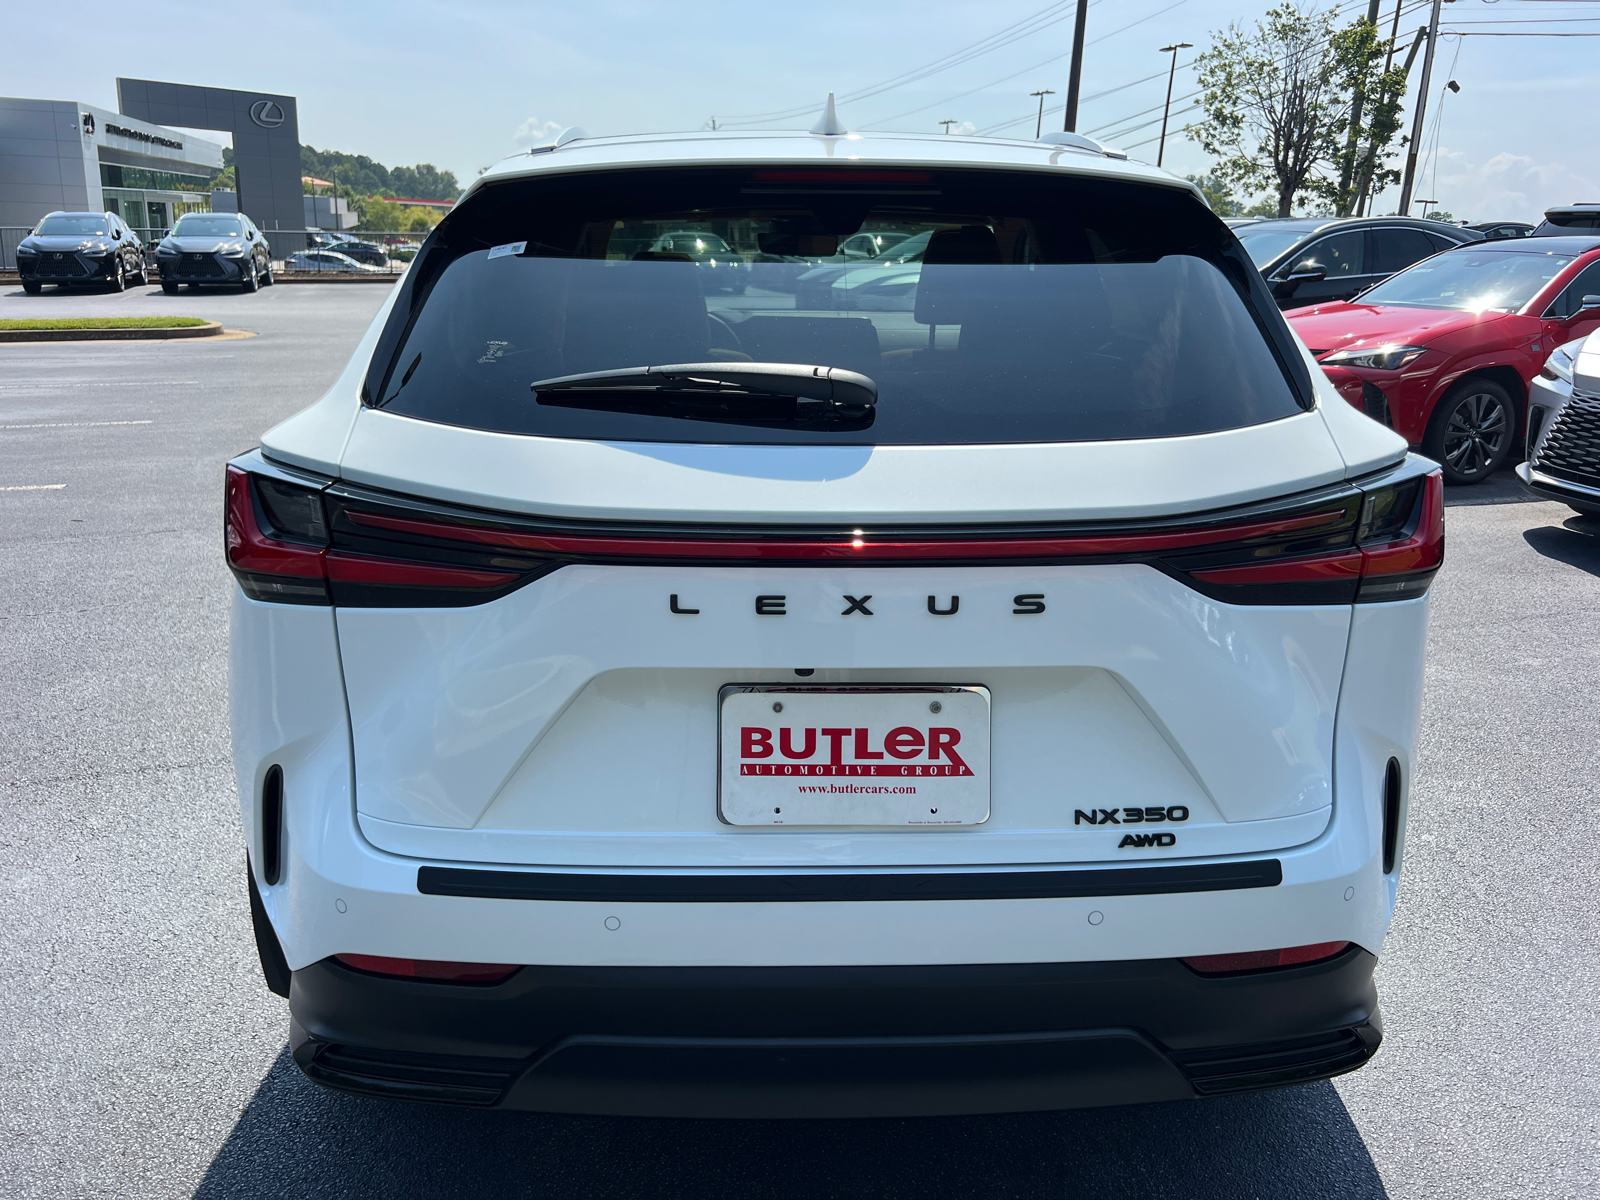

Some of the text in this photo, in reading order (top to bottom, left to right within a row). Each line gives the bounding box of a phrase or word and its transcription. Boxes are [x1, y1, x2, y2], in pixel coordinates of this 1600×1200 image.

[669, 593, 1046, 616] LEXUS
[741, 765, 966, 776] AUTOMOTIVE GROUP
[798, 783, 917, 795] www.butlercars.com
[1074, 805, 1190, 826] NX350
[1117, 832, 1176, 849] AWD
